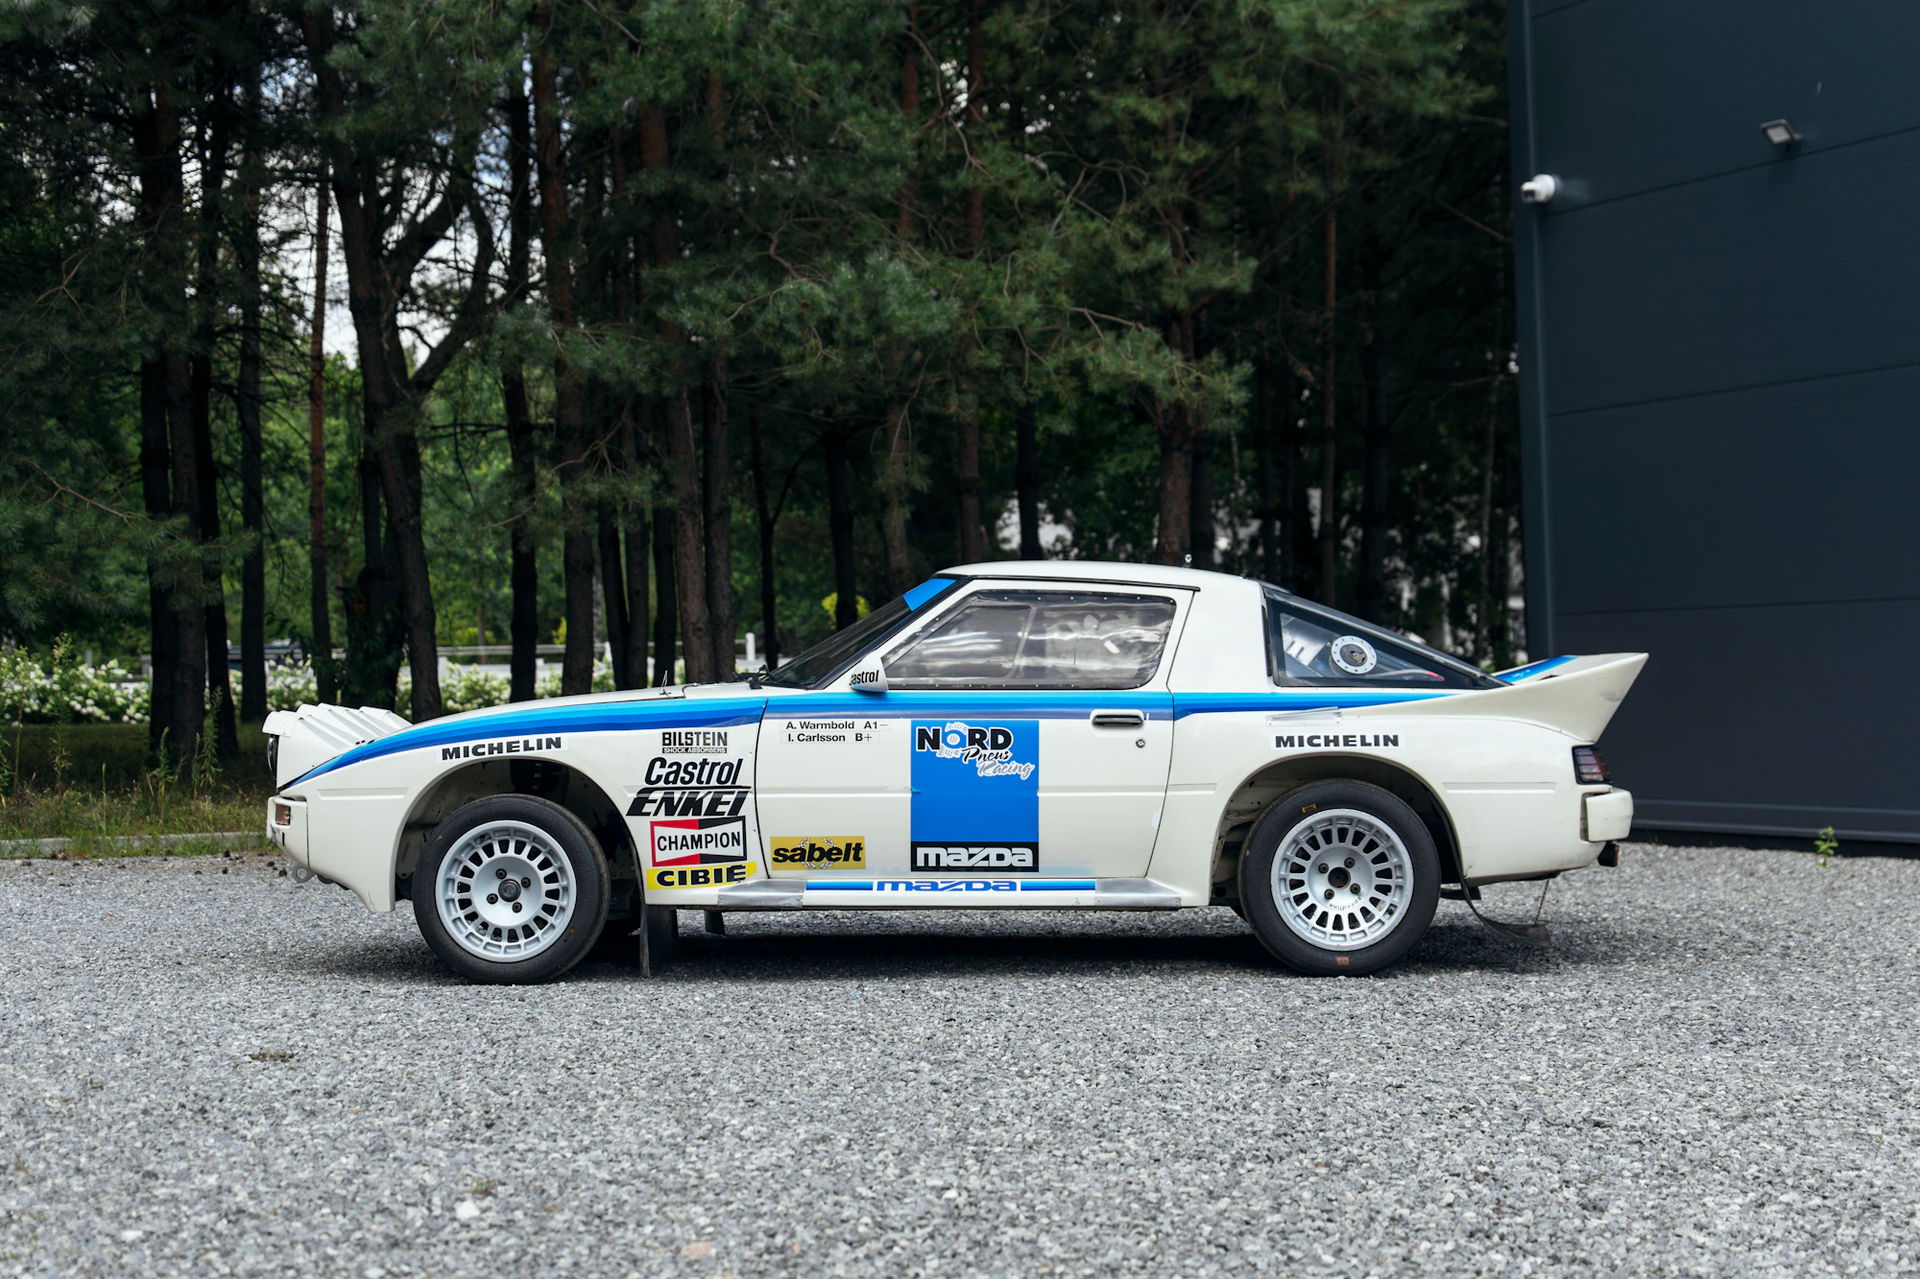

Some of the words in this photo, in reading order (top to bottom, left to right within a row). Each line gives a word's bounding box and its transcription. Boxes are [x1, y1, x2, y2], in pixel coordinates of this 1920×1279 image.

[849, 669, 880, 686] astrol
[785, 721, 797, 730] A.
[799, 721, 855, 730] Warmbold
[662, 731, 728, 747] BILSTEIN
[788, 733, 795, 742] I.
[797, 733, 846, 742] Carlsson
[855, 733, 873, 742] B+
[917, 727, 1012, 751] NORD
[1275, 734, 1399, 748] MICHELIN
[441, 736, 562, 761] MICHELIN
[962, 746, 1009, 763] Pneus
[644, 756, 744, 786] Castrol
[979, 759, 1033, 779] Racing
[626, 786, 752, 817] ENKEI
[656, 831, 741, 852] CHAMPION
[772, 842, 864, 864] sabelt
[916, 847, 1033, 867] mazda
[876, 880, 1017, 892] mazda
